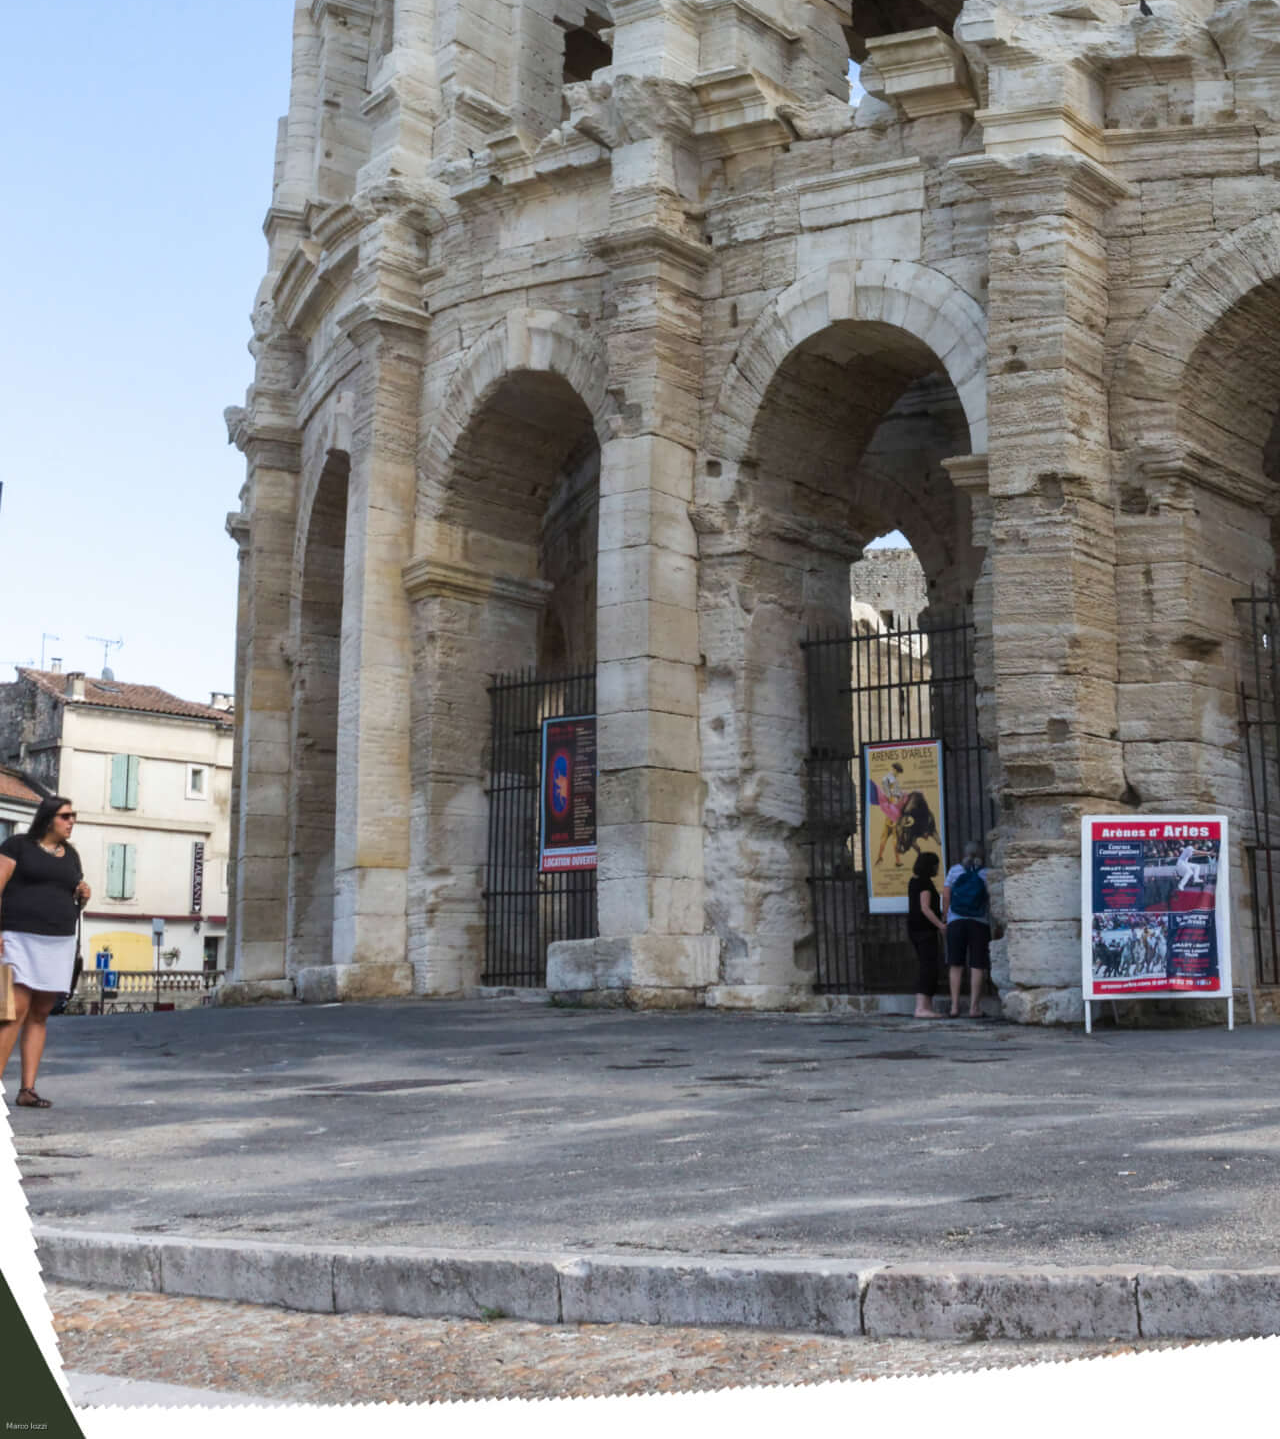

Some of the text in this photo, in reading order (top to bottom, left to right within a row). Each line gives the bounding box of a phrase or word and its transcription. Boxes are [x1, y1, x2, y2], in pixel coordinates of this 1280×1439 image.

[1101, 828, 1146, 838] Arènes
[1163, 825, 1209, 837] Arles
[544, 855, 571, 868] LOCATION
